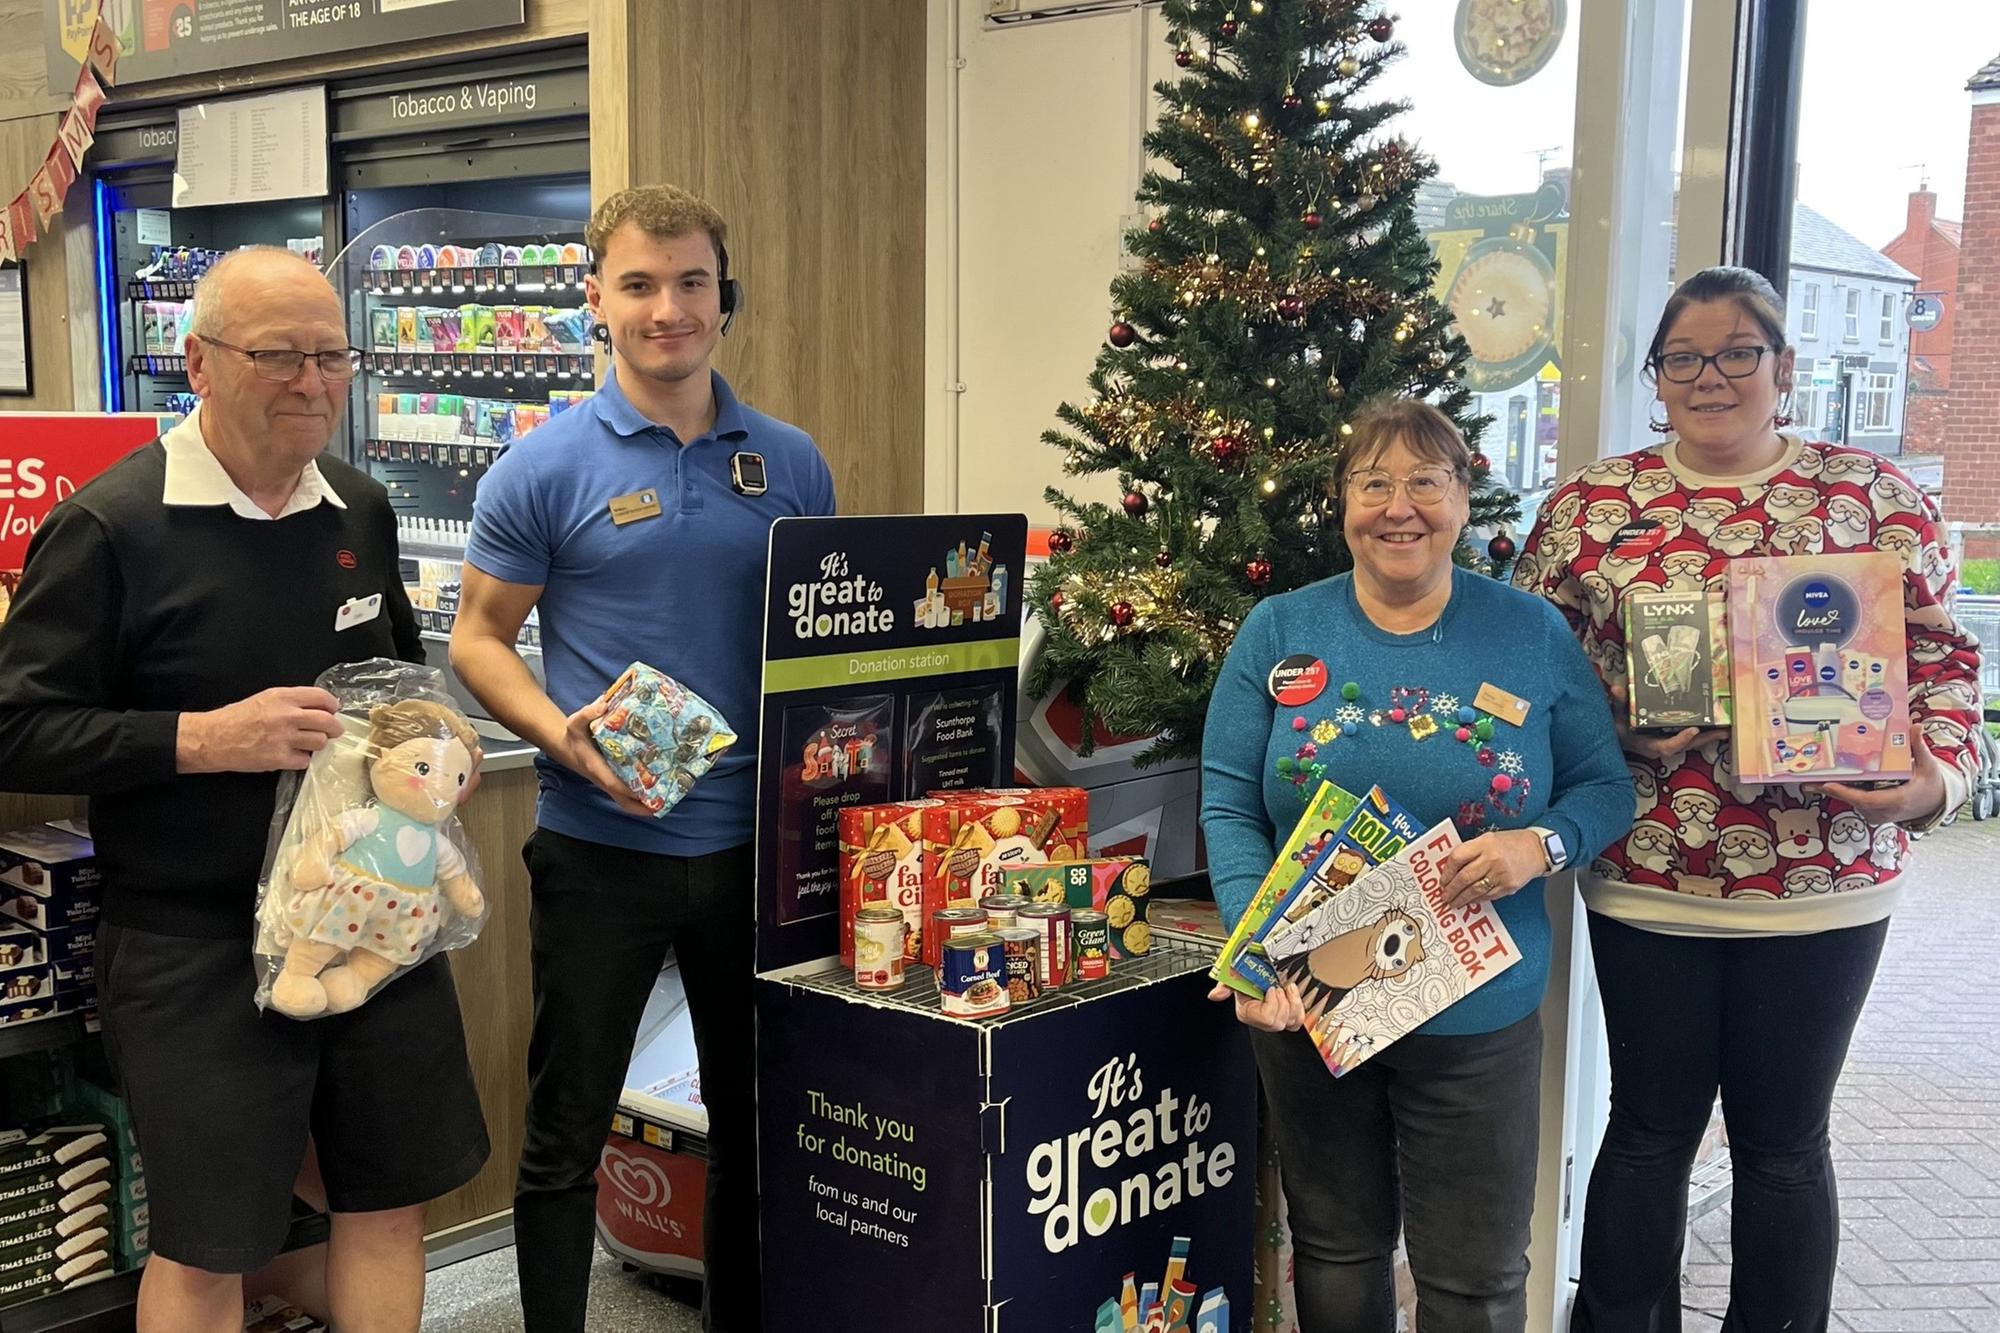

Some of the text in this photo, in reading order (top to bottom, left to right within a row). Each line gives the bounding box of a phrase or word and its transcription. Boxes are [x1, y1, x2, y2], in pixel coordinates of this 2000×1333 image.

[290, 13, 309, 28] THE
[310, 9, 331, 24] AGE
[332, 5, 347, 21] OF
[348, 2, 361, 18] 18
[175, 17, 192, 38] 25
[389, 82, 536, 118] Tobacco & Vaping
[820, 551, 849, 580] It's
[788, 574, 883, 618] great to
[1805, 591, 1829, 599] NIVEA
[1643, 603, 1695, 617] LYNX
[795, 604, 895, 639] donate
[1797, 609, 1836, 627] love
[850, 652, 950, 675] Donation station
[1275, 668, 1304, 678] UNDER
[1790, 675, 1813, 685] LOVE
[936, 715, 976, 729] Scunthorpe
[830, 724, 858, 739] Secret
[936, 727, 974, 742] Food Bank
[939, 766, 969, 778] Tinned meat
[942, 777, 964, 788] UHT milk
[813, 791, 861, 807] Please drop
[821, 809, 833, 820] off
[816, 824, 836, 836] food
[1347, 808, 1391, 854] 101
[1428, 833, 1509, 961] FRET
[1409, 850, 1486, 979] COLORING BOOK
[1078, 929, 1105, 939] Green
[1080, 935, 1106, 946] Giant
[961, 969, 1001, 983] Corned Beef
[1087, 1052, 1143, 1119] It's
[807, 1090, 914, 1143] Thank you
[797, 1123, 927, 1192] for donating
[1026, 1088, 1212, 1215] great to
[24, 1155, 51, 1168] SLICES
[27, 1180, 55, 1194] SLICES
[808, 1175, 918, 1224] from us and our
[1043, 1141, 1235, 1254] donate
[28, 1203, 56, 1217] SLICES
[615, 1198, 682, 1239] WALL'S
[816, 1201, 909, 1248] local partners
[25, 1227, 53, 1242] SLICES
[25, 1251, 53, 1265] SLICES
[24, 1273, 52, 1287] SLICES
